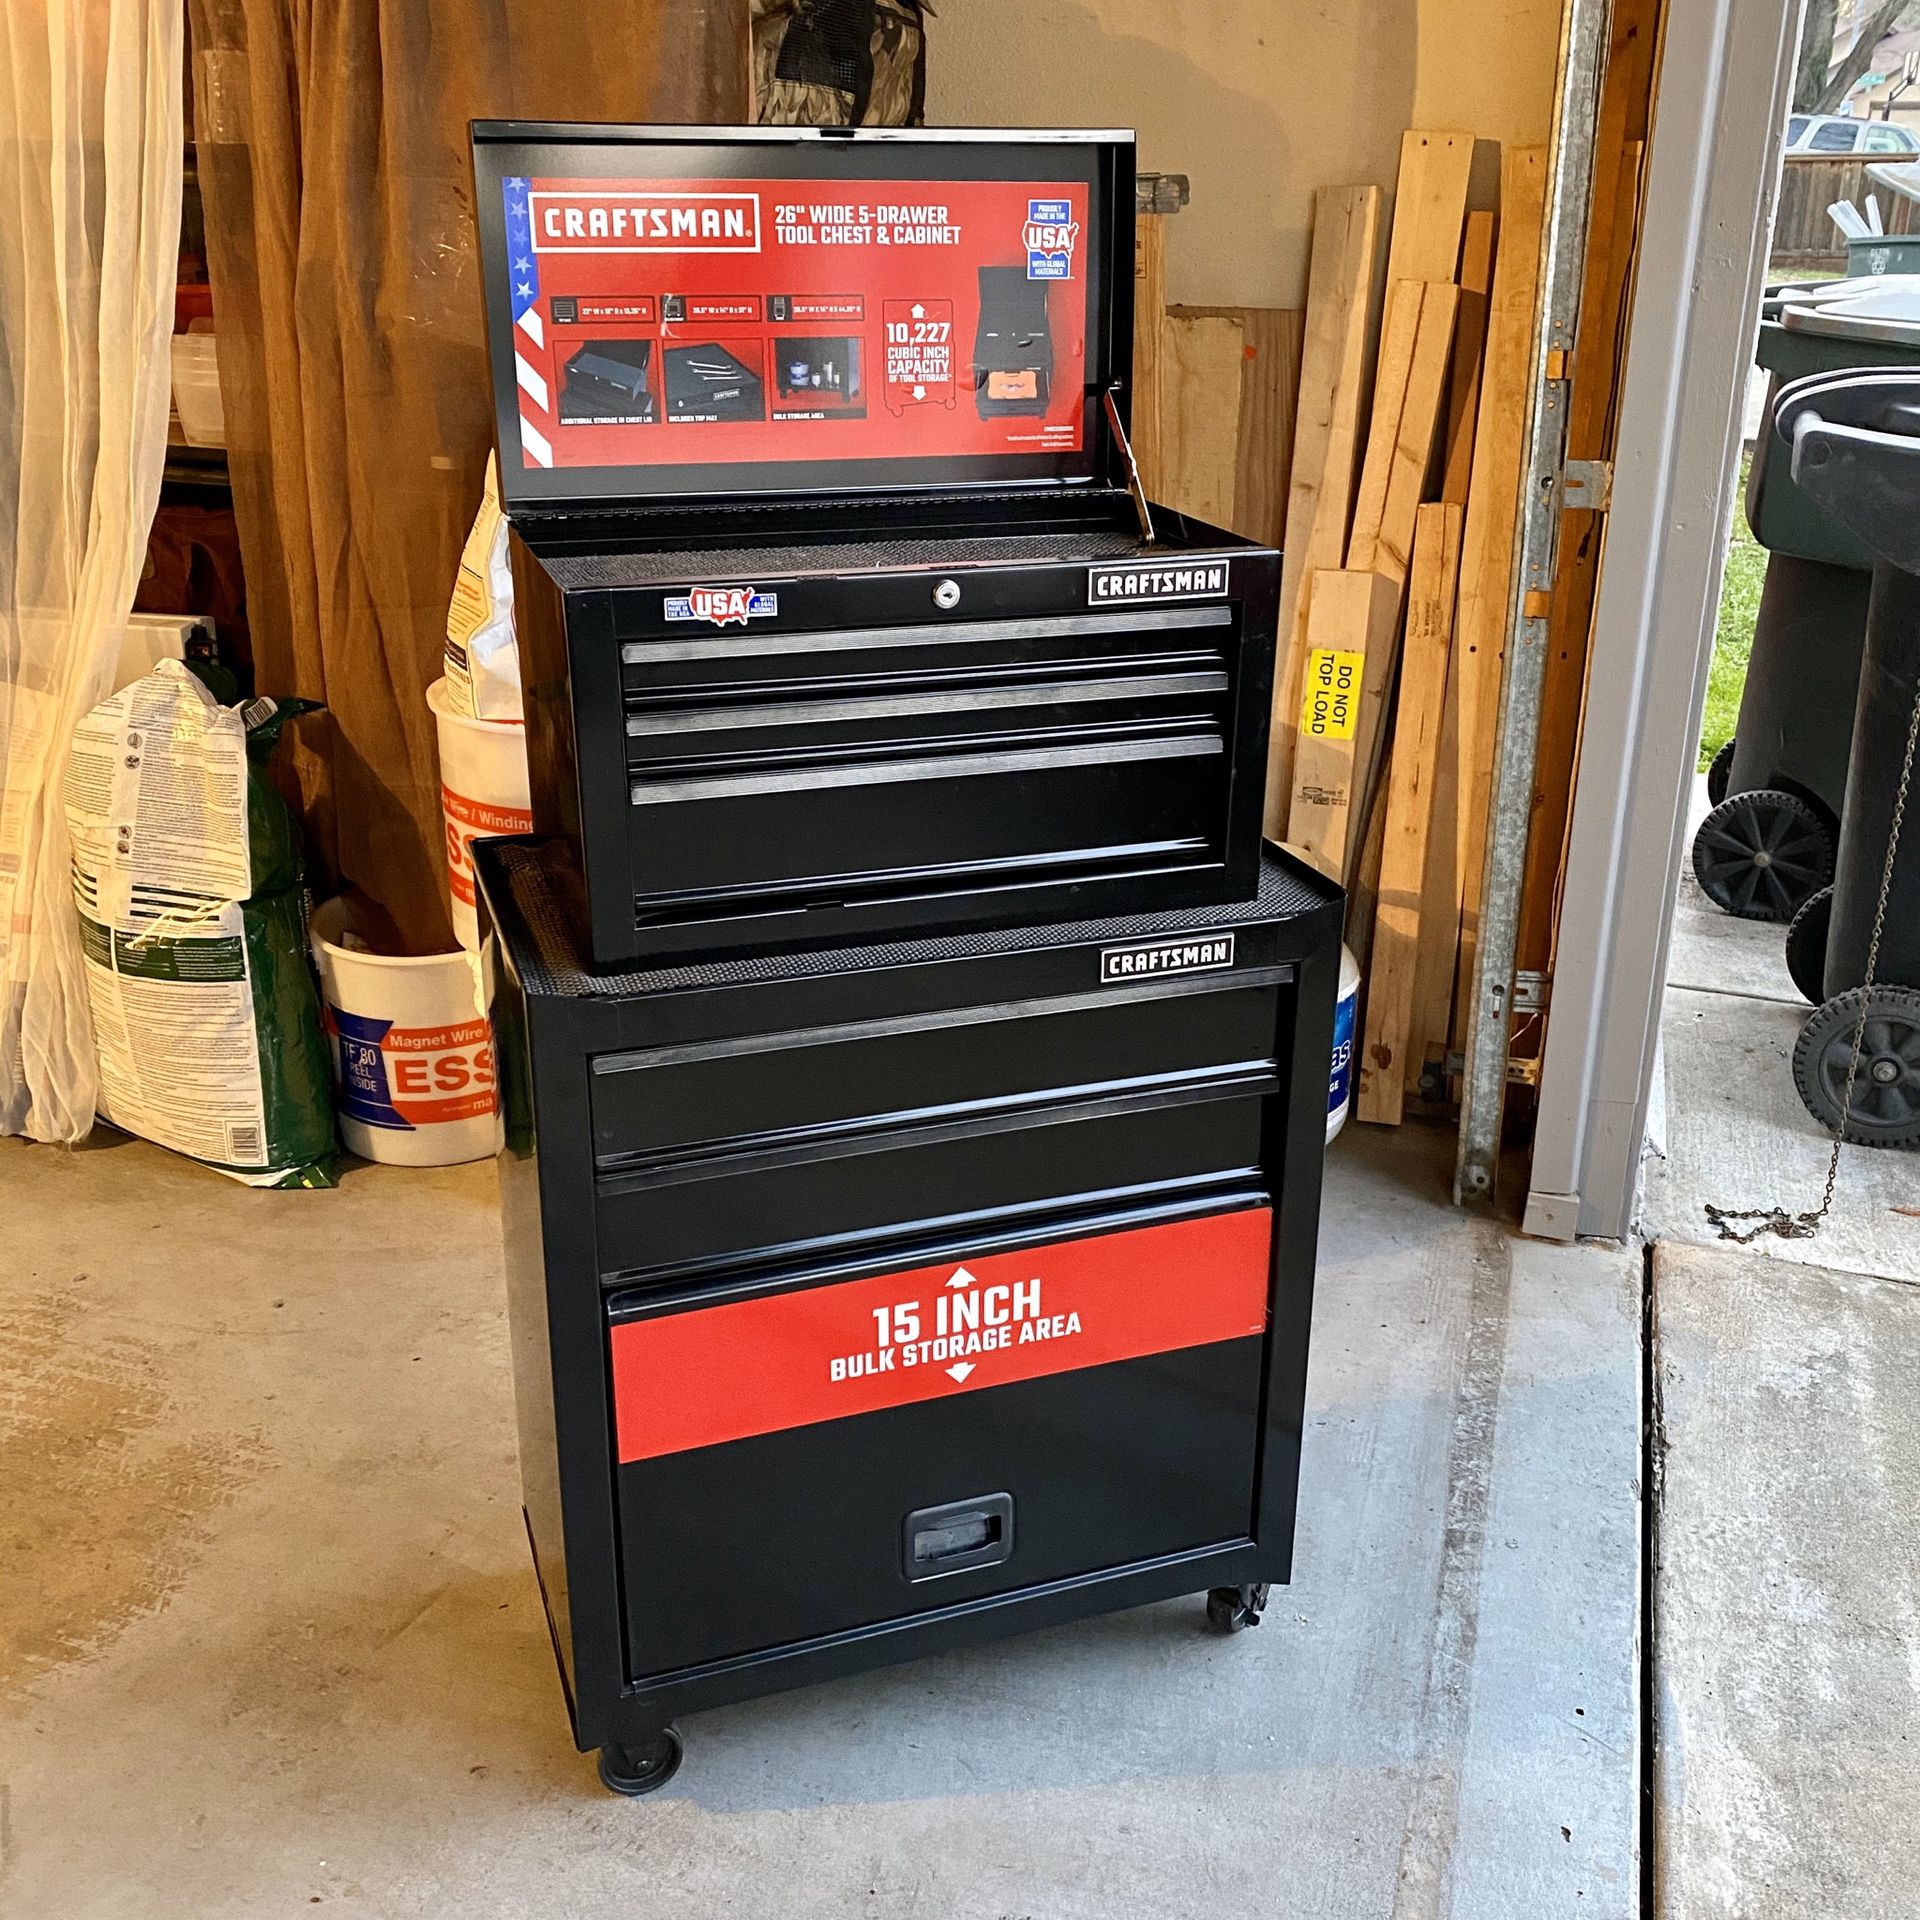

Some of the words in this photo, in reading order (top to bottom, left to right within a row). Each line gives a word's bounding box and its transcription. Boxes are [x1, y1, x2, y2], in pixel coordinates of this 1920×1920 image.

[544, 208, 744, 238] CRAFTSMAN
[775, 205, 805, 224] 26"
[809, 205, 855, 224] WIDE
[858, 205, 948, 224] 5-DRAWER
[775, 226, 817, 244] TOOL
[821, 226, 873, 244] CHEST
[876, 226, 892, 245] &
[893, 226, 961, 244] CABINET
[1028, 226, 1071, 249] USA
[886, 322, 951, 347] 10,227
[887, 346, 920, 359] CUBIC
[923, 346, 950, 359] INCH
[887, 360, 950, 374] CAPACITY
[888, 374, 898, 383] OF
[900, 374, 916, 382] TOOL
[1097, 568, 1222, 597] CRAFTSMAN
[696, 592, 746, 616] USA
[1318, 654, 1335, 686] TOP
[1336, 666, 1352, 690] DO
[1312, 692, 1330, 734] LOAD
[1332, 694, 1349, 728] NOT
[1109, 941, 1227, 975] CRAFTSMAN
[389, 1033, 446, 1050] Magnet
[451, 1027, 484, 1043] Wire
[350, 1062, 372, 1079] REEL
[350, 1075, 377, 1092] NSIDE
[872, 1300, 920, 1348] 15
[936, 1278, 1041, 1336] INCH
[830, 1347, 895, 1382] BULK
[902, 1324, 1012, 1367] STORAGE
[1018, 1311, 1082, 1345] AREA
